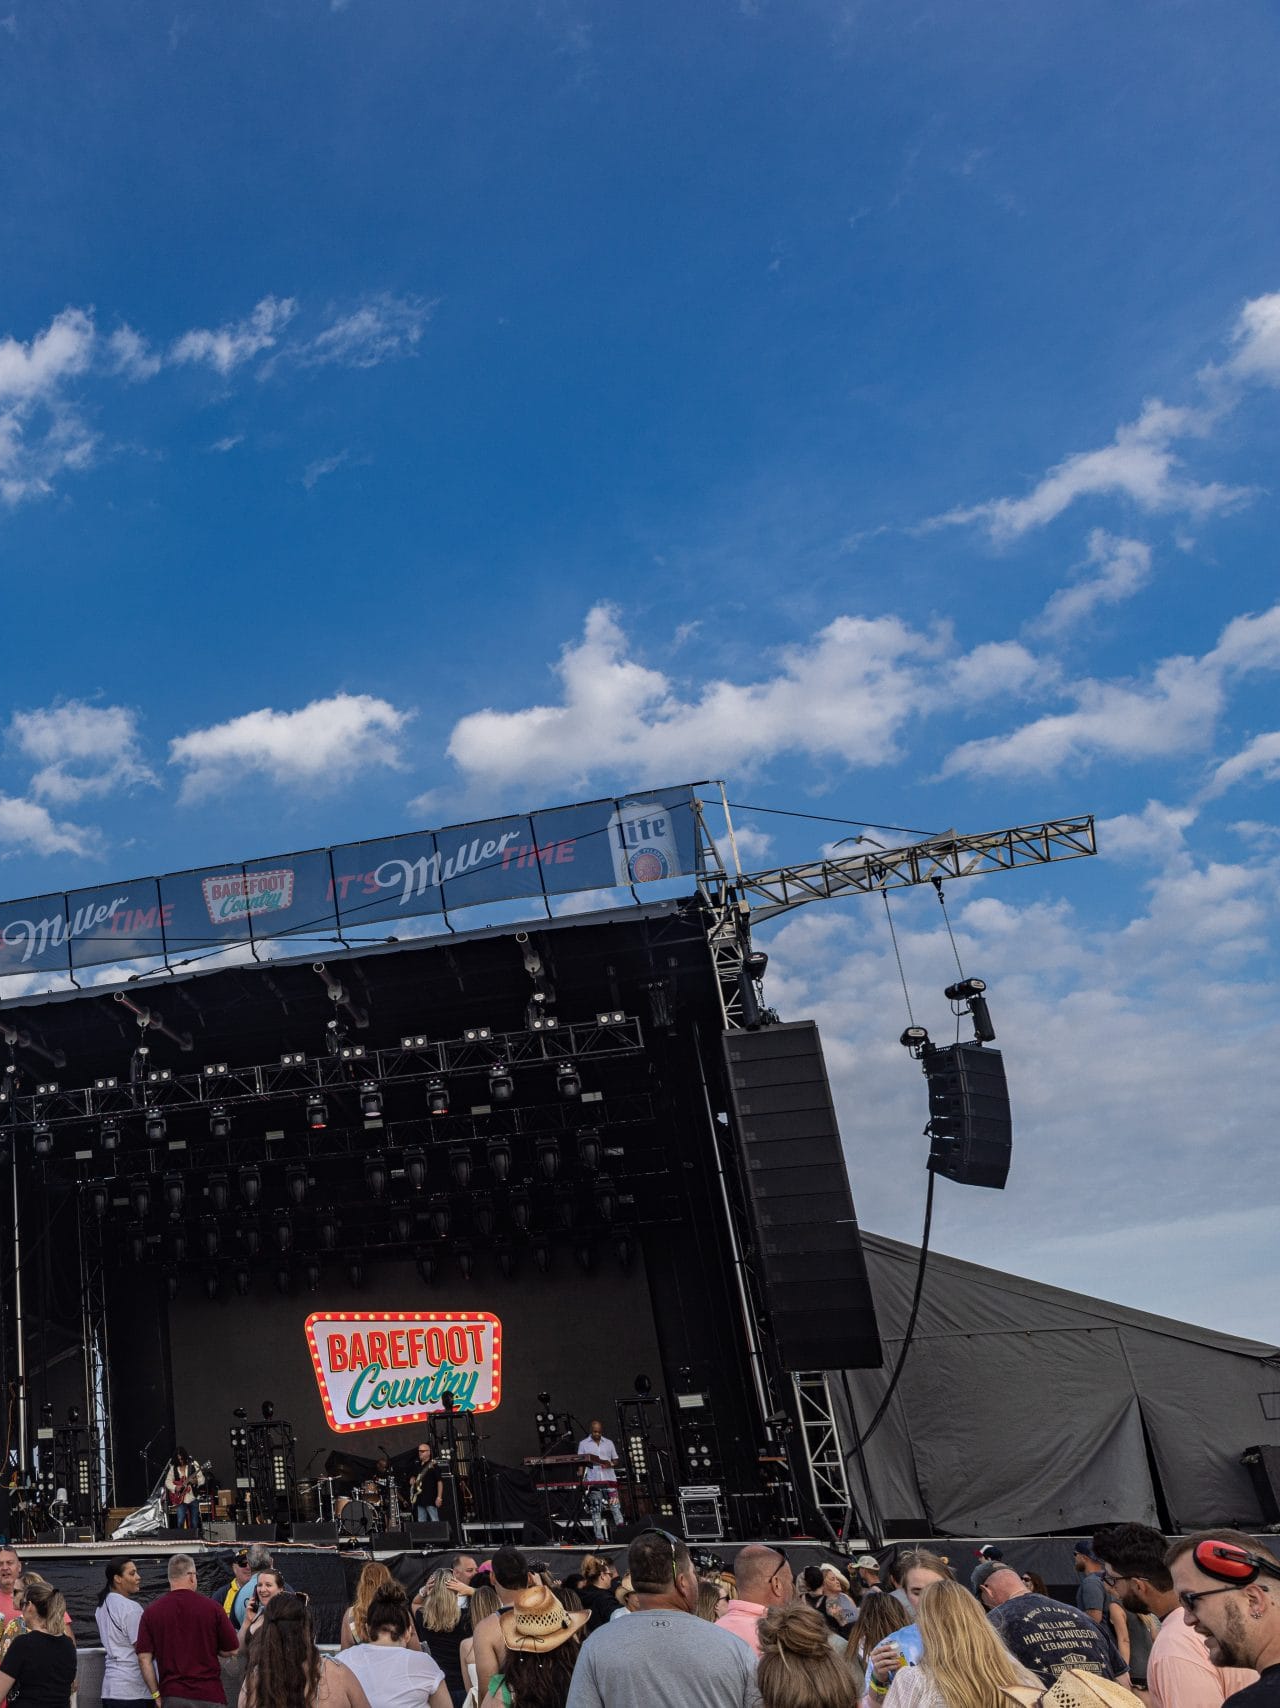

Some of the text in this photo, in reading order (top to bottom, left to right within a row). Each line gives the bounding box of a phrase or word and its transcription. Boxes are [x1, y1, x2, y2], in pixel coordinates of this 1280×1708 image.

[615, 818, 666, 850] Lite
[326, 831, 576, 906] IT'S Miller TIME
[211, 874, 287, 900] BAREFOOT
[219, 889, 283, 918] Country
[2, 896, 129, 963] Miller
[109, 904, 176, 934] TIME
[327, 1324, 486, 1373] BAREFOOT
[346, 1360, 480, 1418] Country
[1023, 1630, 1098, 1645] HARLEY-DAVIDSON
[1036, 1620, 1077, 1630] WILLIAMS
[1081, 1640, 1093, 1649] NJ
